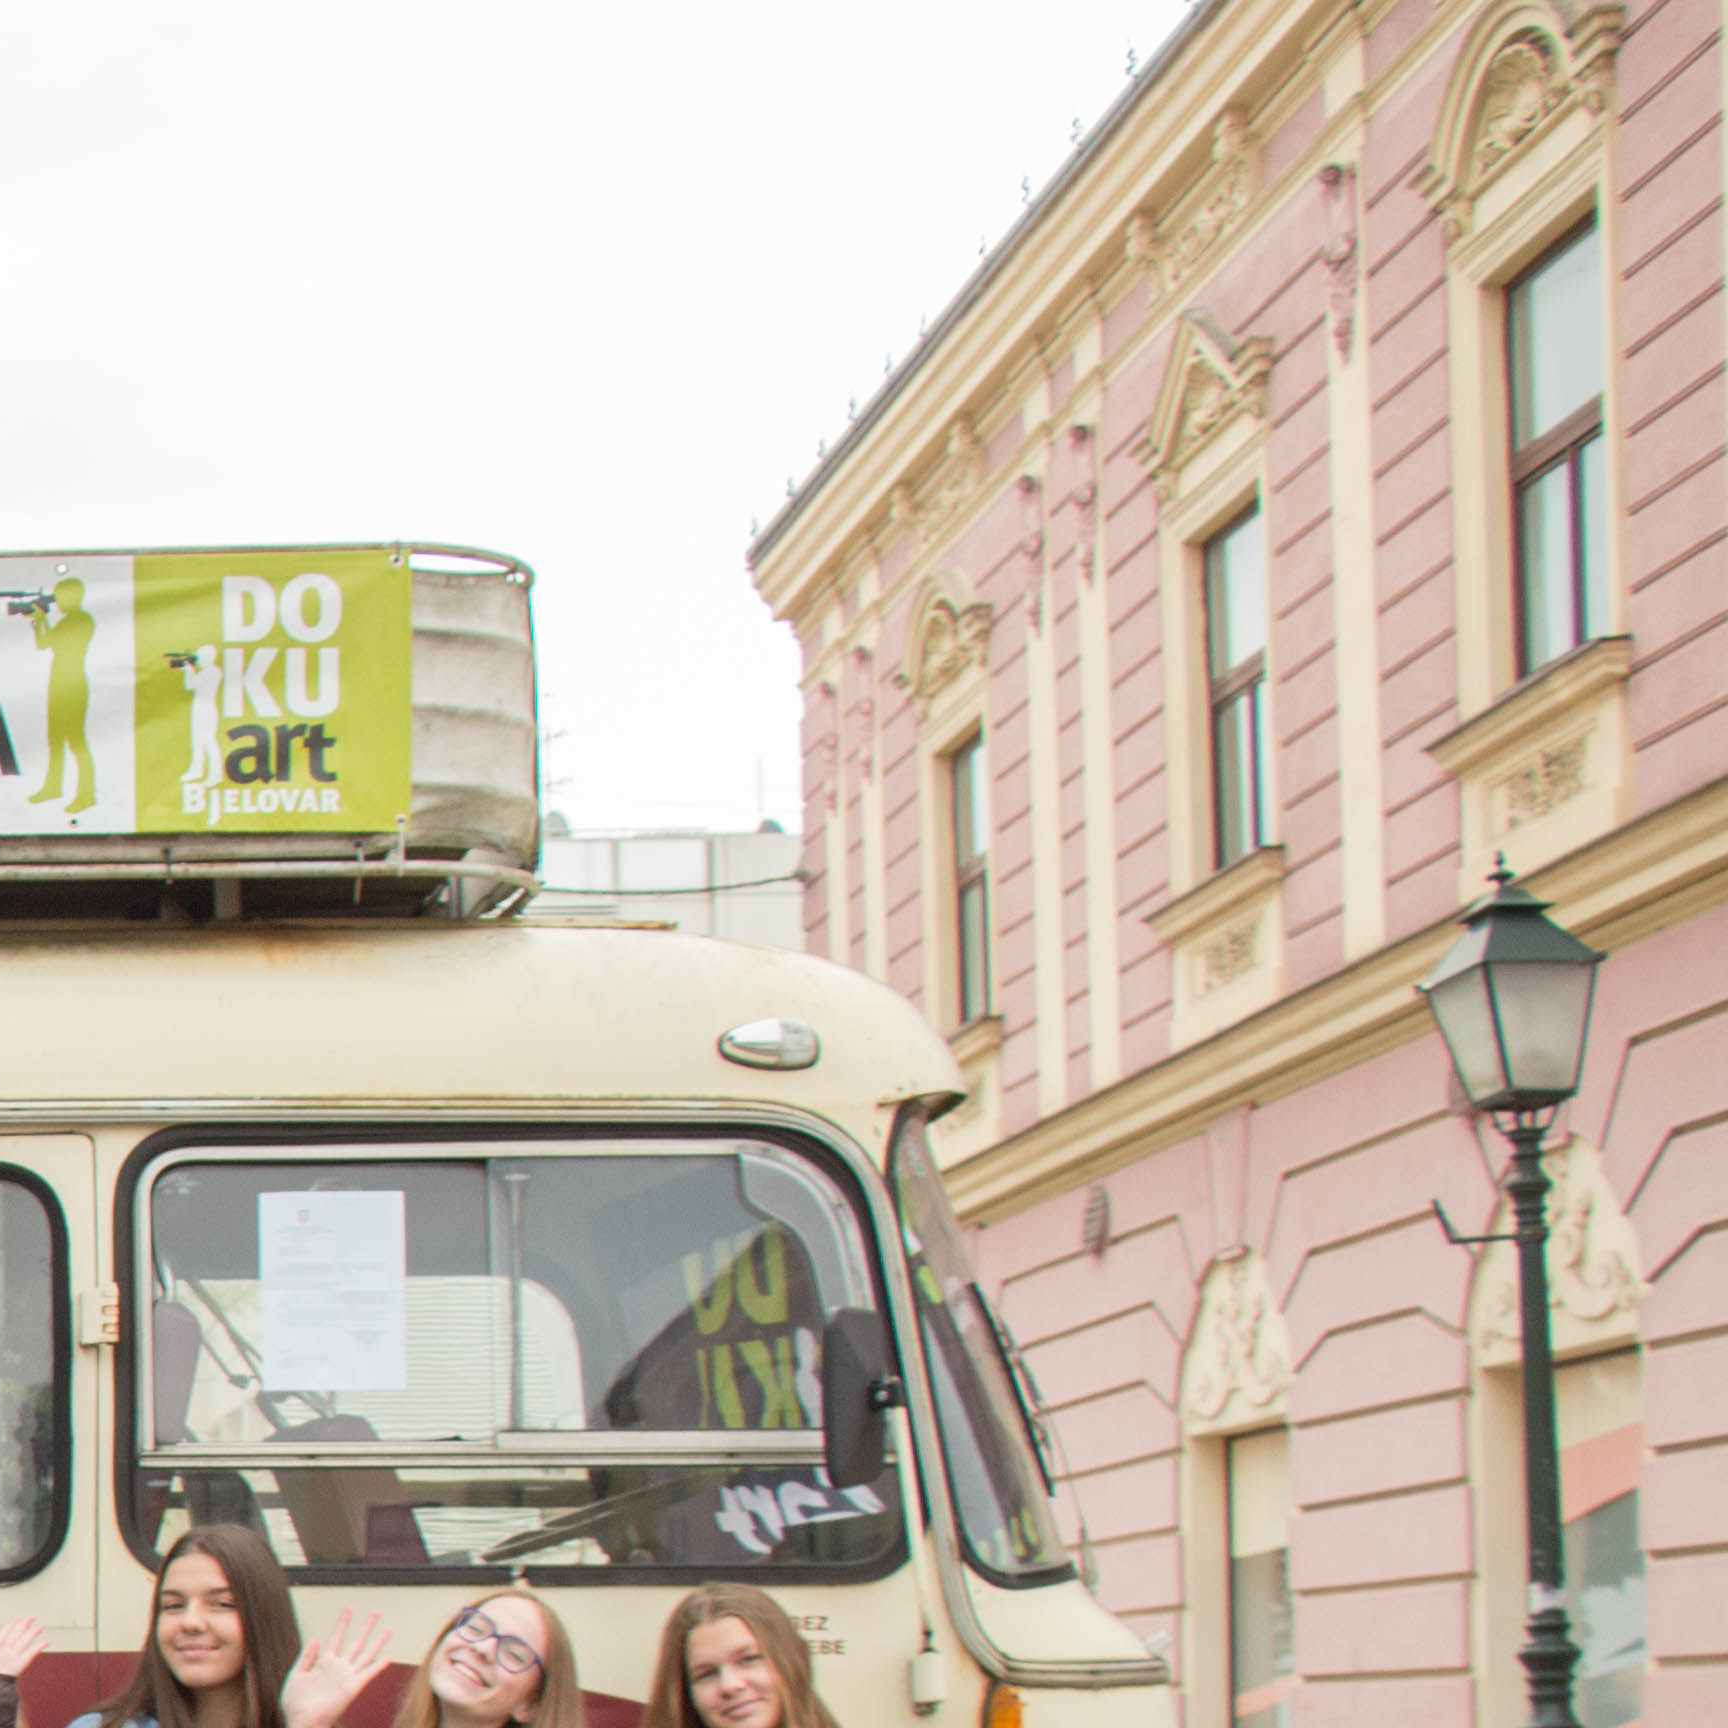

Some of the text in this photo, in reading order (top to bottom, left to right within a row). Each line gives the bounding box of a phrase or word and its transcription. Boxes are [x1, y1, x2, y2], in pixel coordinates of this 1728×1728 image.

[222, 574, 341, 642] DO
[222, 647, 340, 717] KU
[224, 720, 335, 784] art
[181, 784, 341, 825] BJELOVAR
